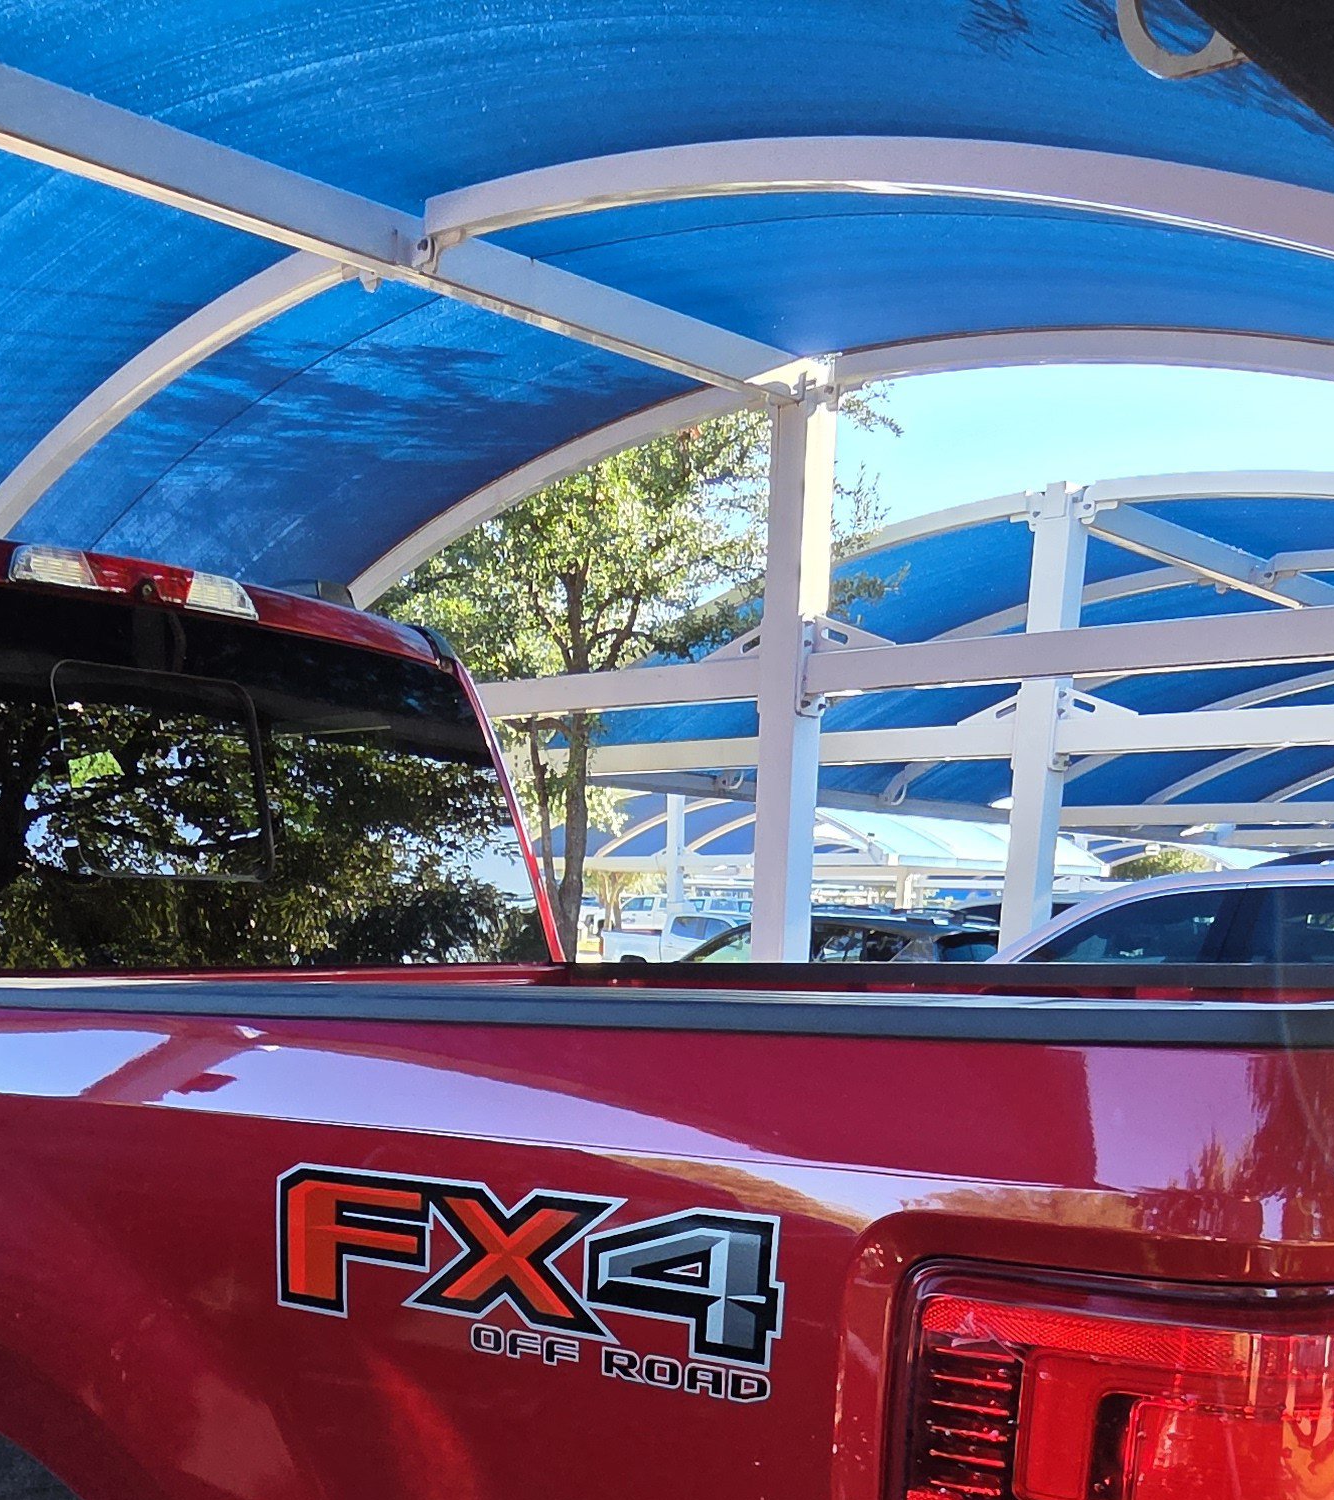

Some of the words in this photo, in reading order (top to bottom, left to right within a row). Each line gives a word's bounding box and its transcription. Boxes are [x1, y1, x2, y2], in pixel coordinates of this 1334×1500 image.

[276, 1162, 785, 1372] FX4
[470, 1323, 580, 1366] OFF
[601, 1346, 771, 1403] ROAD
